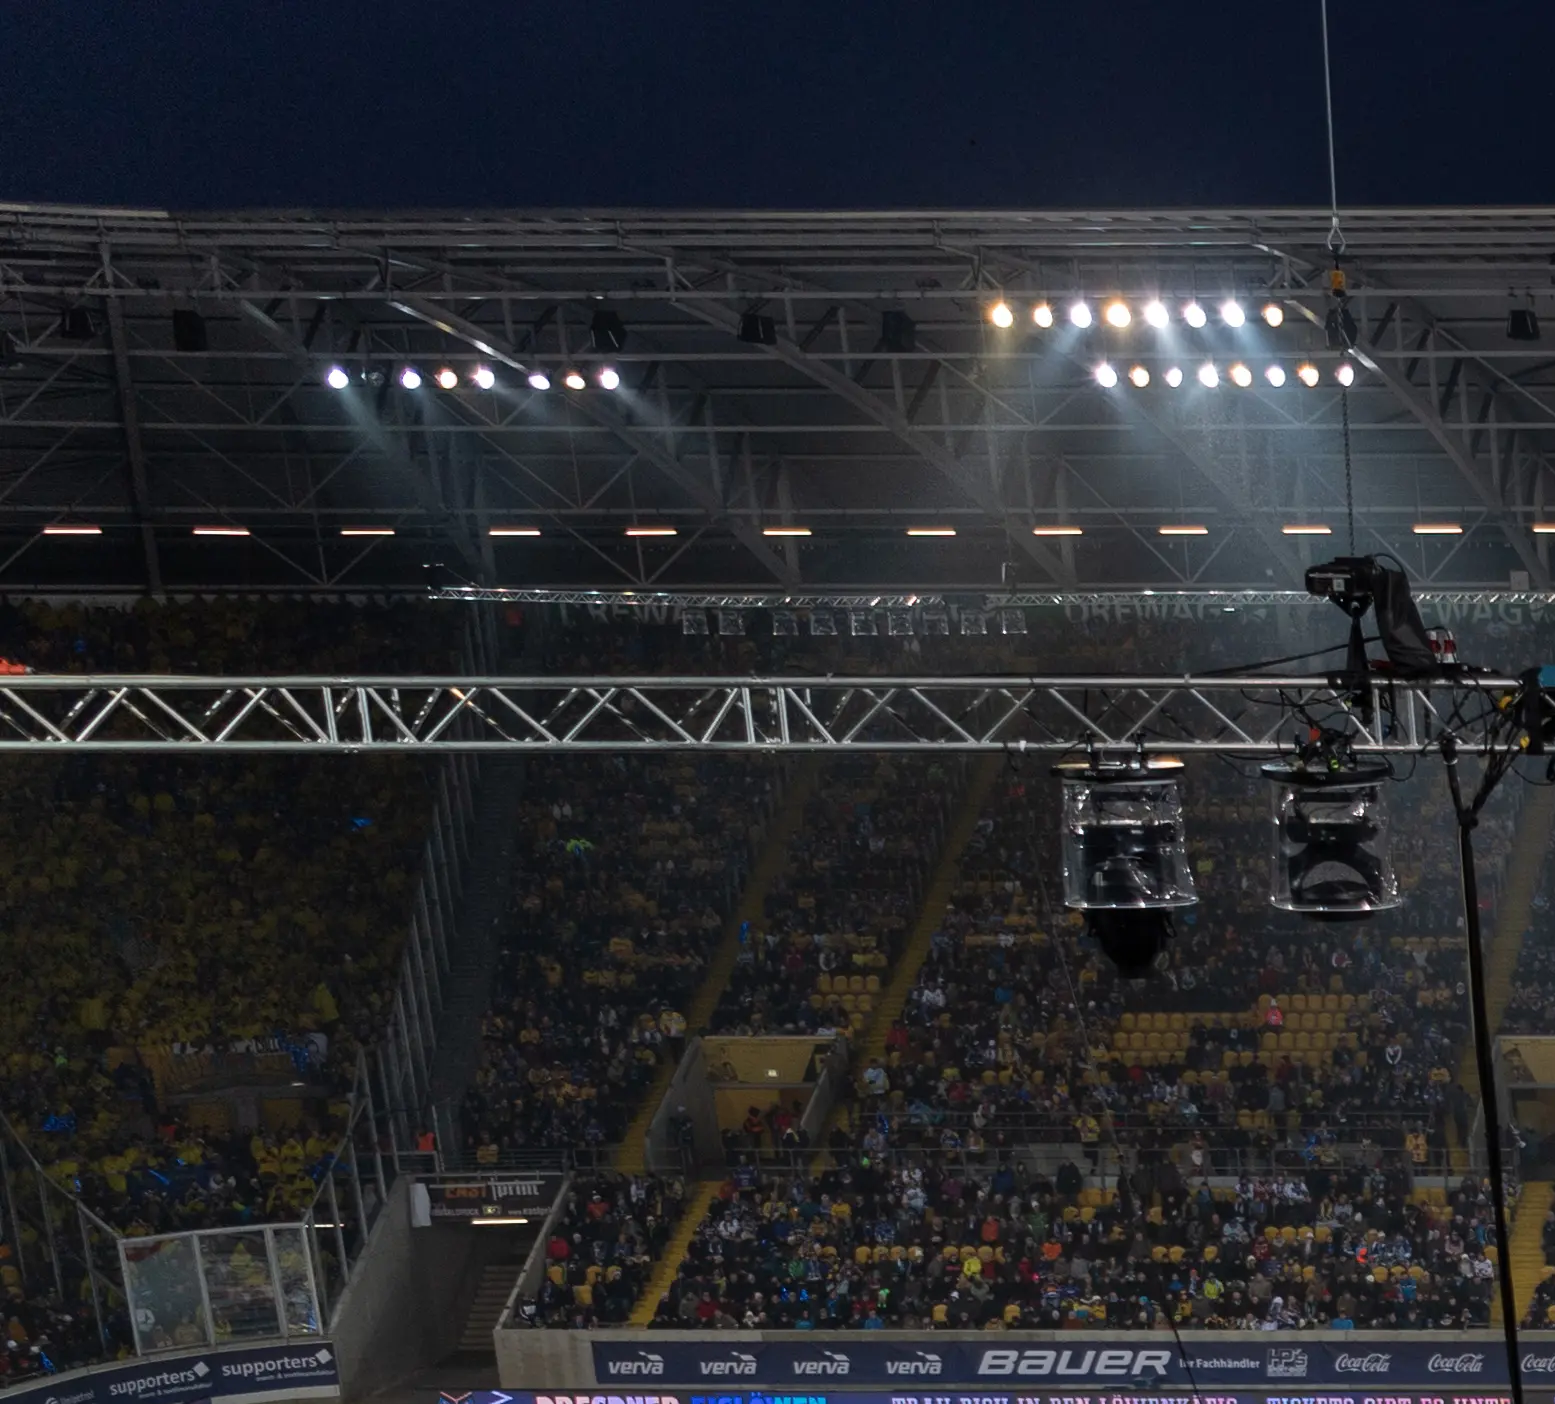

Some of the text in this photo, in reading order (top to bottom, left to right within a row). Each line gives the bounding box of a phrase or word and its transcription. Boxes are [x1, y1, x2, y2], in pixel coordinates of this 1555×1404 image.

[222, 1356, 317, 1379] supporters
[608, 1361, 664, 1375] verva
[700, 1361, 756, 1375] verva
[794, 1361, 849, 1375] verva
[886, 1361, 942, 1375] verva
[1195, 1358, 1261, 1373] Fachhändler
[109, 1370, 195, 1397] supporters
